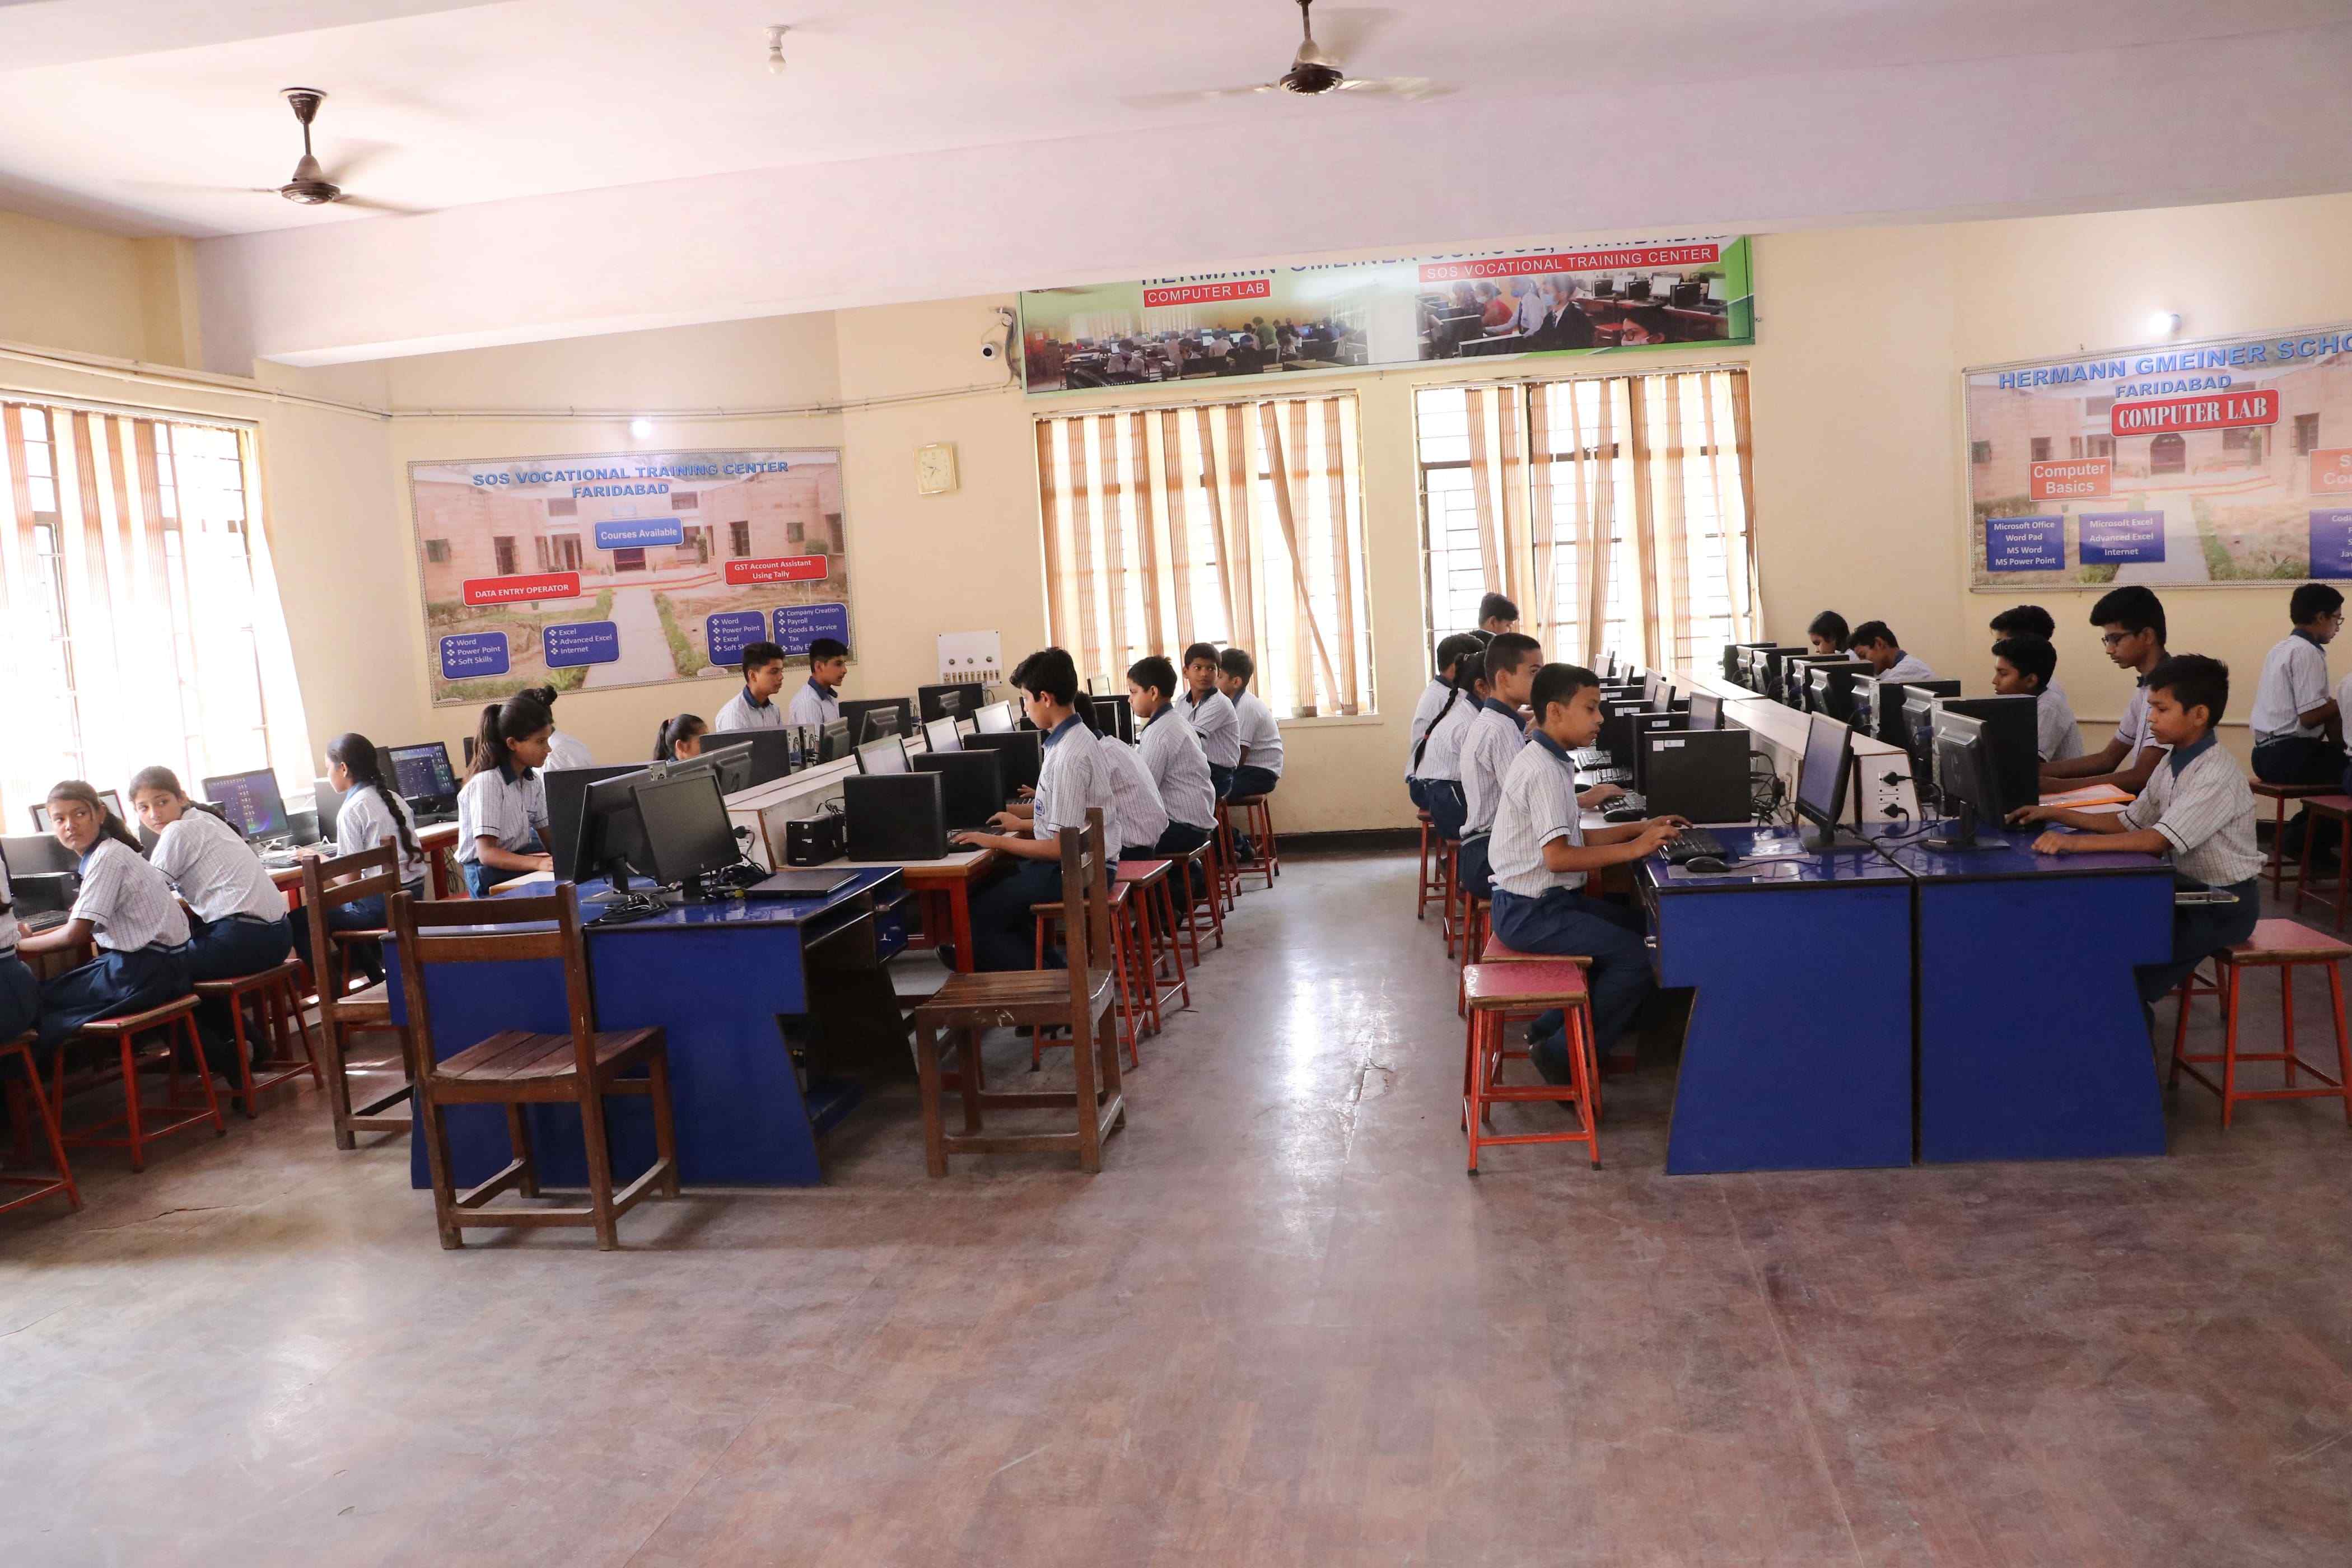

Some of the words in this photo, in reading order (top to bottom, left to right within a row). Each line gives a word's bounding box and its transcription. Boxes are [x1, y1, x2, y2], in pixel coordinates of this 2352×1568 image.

[1427, 266, 1458, 279] SOS
[1464, 258, 1562, 276] VOCATIONAL
[1567, 253, 1642, 268] TRAINING
[1648, 248, 1711, 263] CENTER
[1147, 286, 1232, 303] COMPUTER
[1237, 283, 1265, 295] LAB
[1999, 360, 2126, 389] HERMANN
[2135, 343, 2267, 375] GMEINER
[2115, 375, 2232, 398] FARIDABAD
[2118, 401, 2221, 429] COMPUTER
[2227, 396, 2268, 420] LAB
[472, 472, 511, 486] SOS
[515, 468, 631, 484] VOCATIONAL
[635, 463, 718, 478] TRAINING
[723, 461, 789, 475] CENTER
[2033, 463, 2106, 479] Computer
[572, 483, 669, 498] FARIDABAD
[2046, 480, 2095, 494] Basics
[1994, 521, 2030, 531] Microsoft
[2089, 519, 2130, 528] Microsoft
[2132, 517, 2153, 526] Excel
[600, 531, 637, 540] Courses
[639, 528, 677, 538] Available
[2028, 533, 2043, 541] Pad
[2089, 533, 2130, 542] Advanced
[2104, 548, 2139, 556] Internet
[498, 588, 524, 596] ENTRY
[526, 584, 570, 594] OPERATOR
[559, 636, 594, 645] Advanced
[595, 633, 612, 642] Excel
[561, 646, 589, 655] Internet
